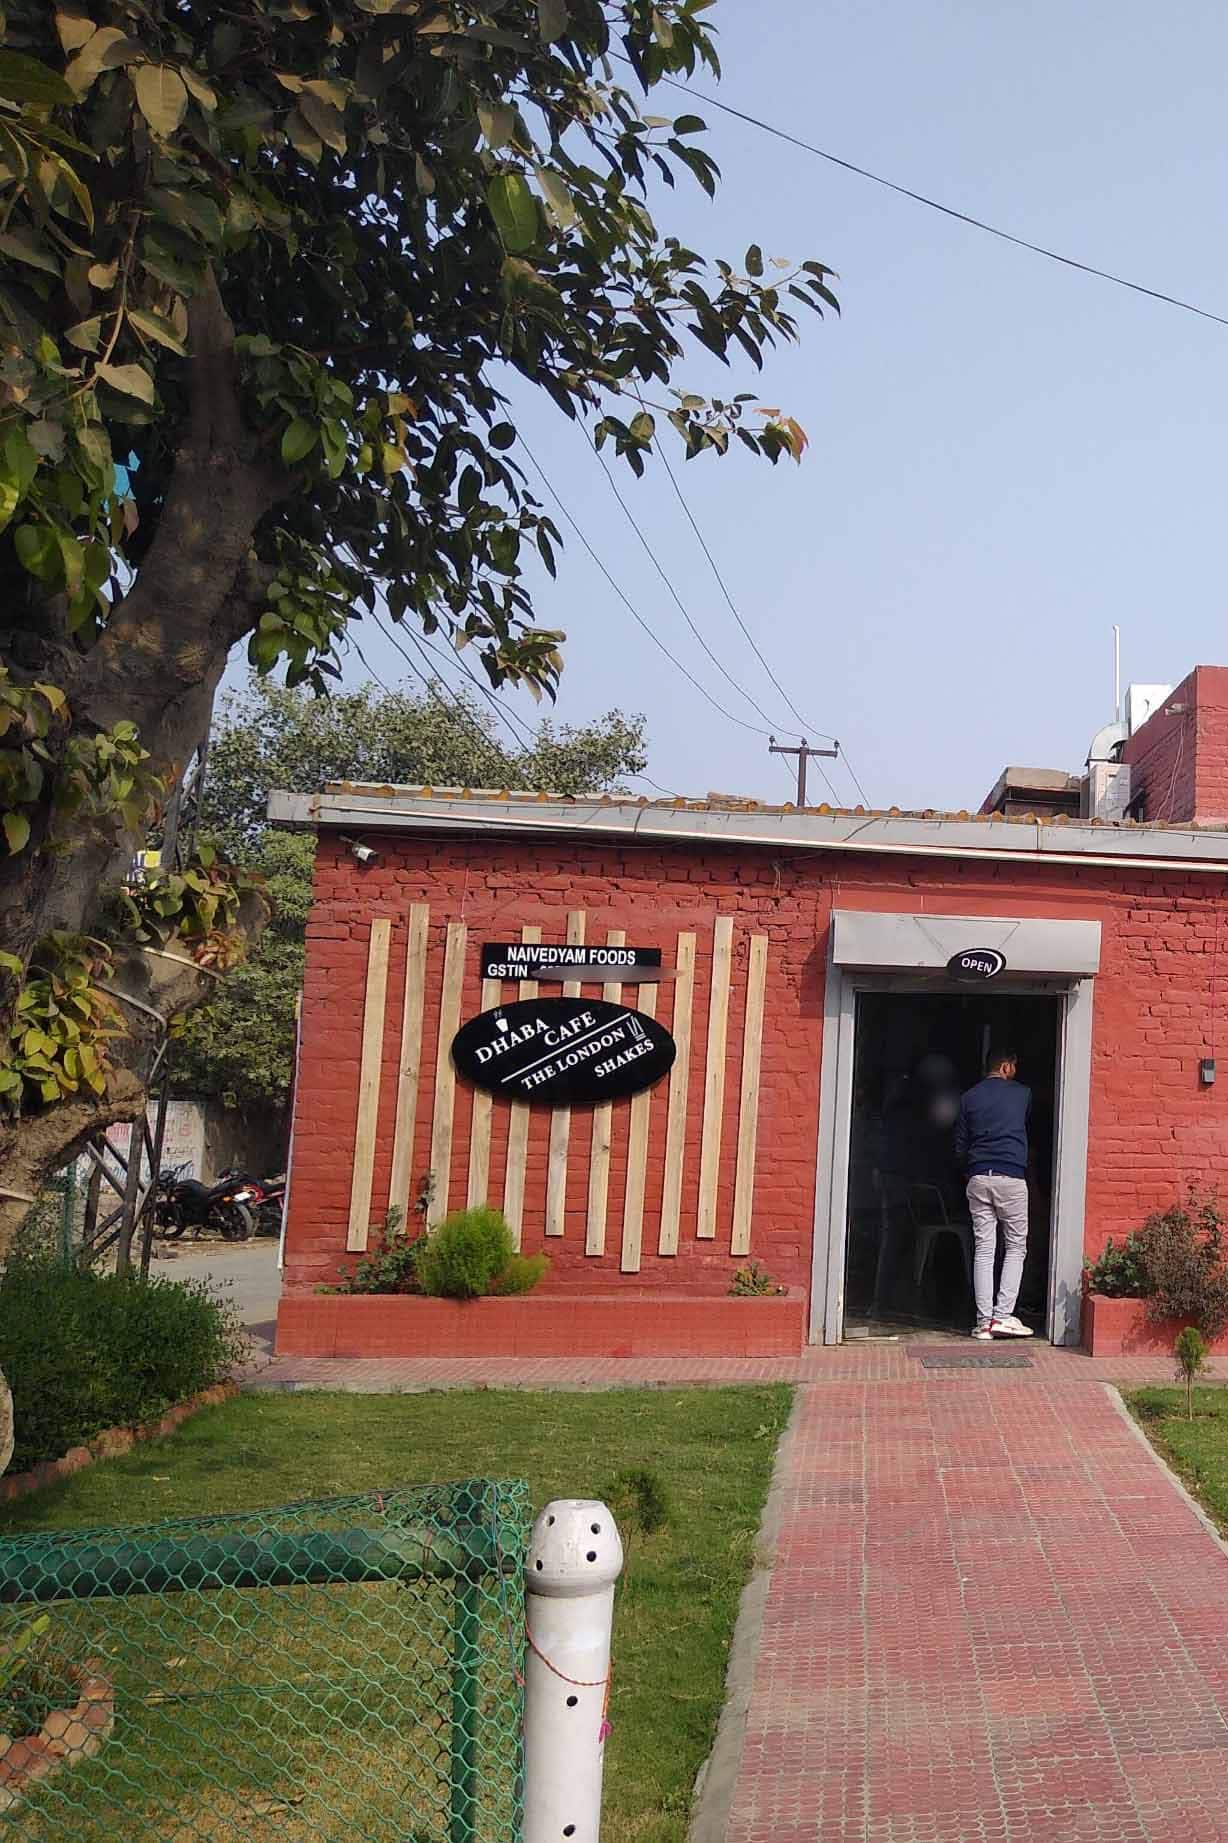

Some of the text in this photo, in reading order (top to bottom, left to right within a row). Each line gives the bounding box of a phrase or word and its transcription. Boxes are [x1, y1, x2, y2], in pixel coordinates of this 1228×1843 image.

[487, 963, 528, 978] GSTIN
[506, 946, 637, 966] NAIVEDYAM FOODS
[960, 957, 993, 974] OPEN
[474, 1018, 550, 1064] DHABA
[543, 1011, 597, 1047] CAFE
[521, 1027, 626, 1091] THE LONDON
[593, 1038, 655, 1078] SHAKES
